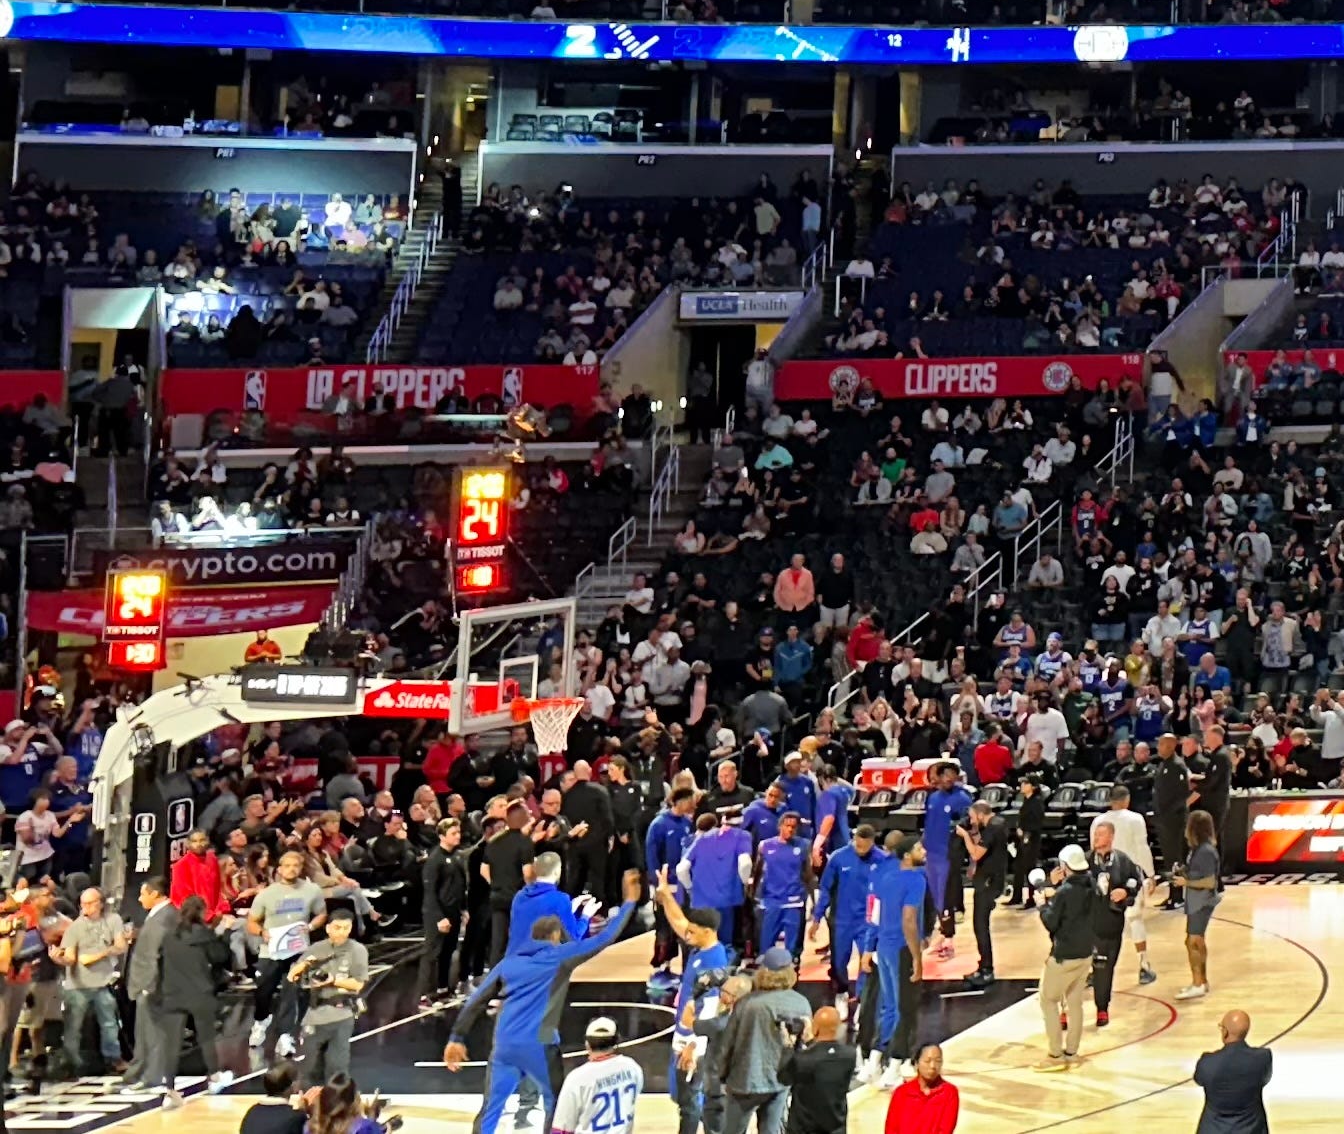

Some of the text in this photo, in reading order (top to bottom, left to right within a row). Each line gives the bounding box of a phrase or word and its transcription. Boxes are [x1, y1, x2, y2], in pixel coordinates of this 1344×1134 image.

[564, 24, 597, 56] 2
[887, 33, 902, 47] 12
[701, 296, 788, 312] UCLA Health
[342, 368, 466, 409] CLIPPERS
[904, 362, 998, 395] CLIPPERS
[462, 499, 499, 540] 24
[146, 551, 337, 579] crypto.com
[57, 600, 306, 628] CLPERS
[397, 692, 450, 710] StateFa
